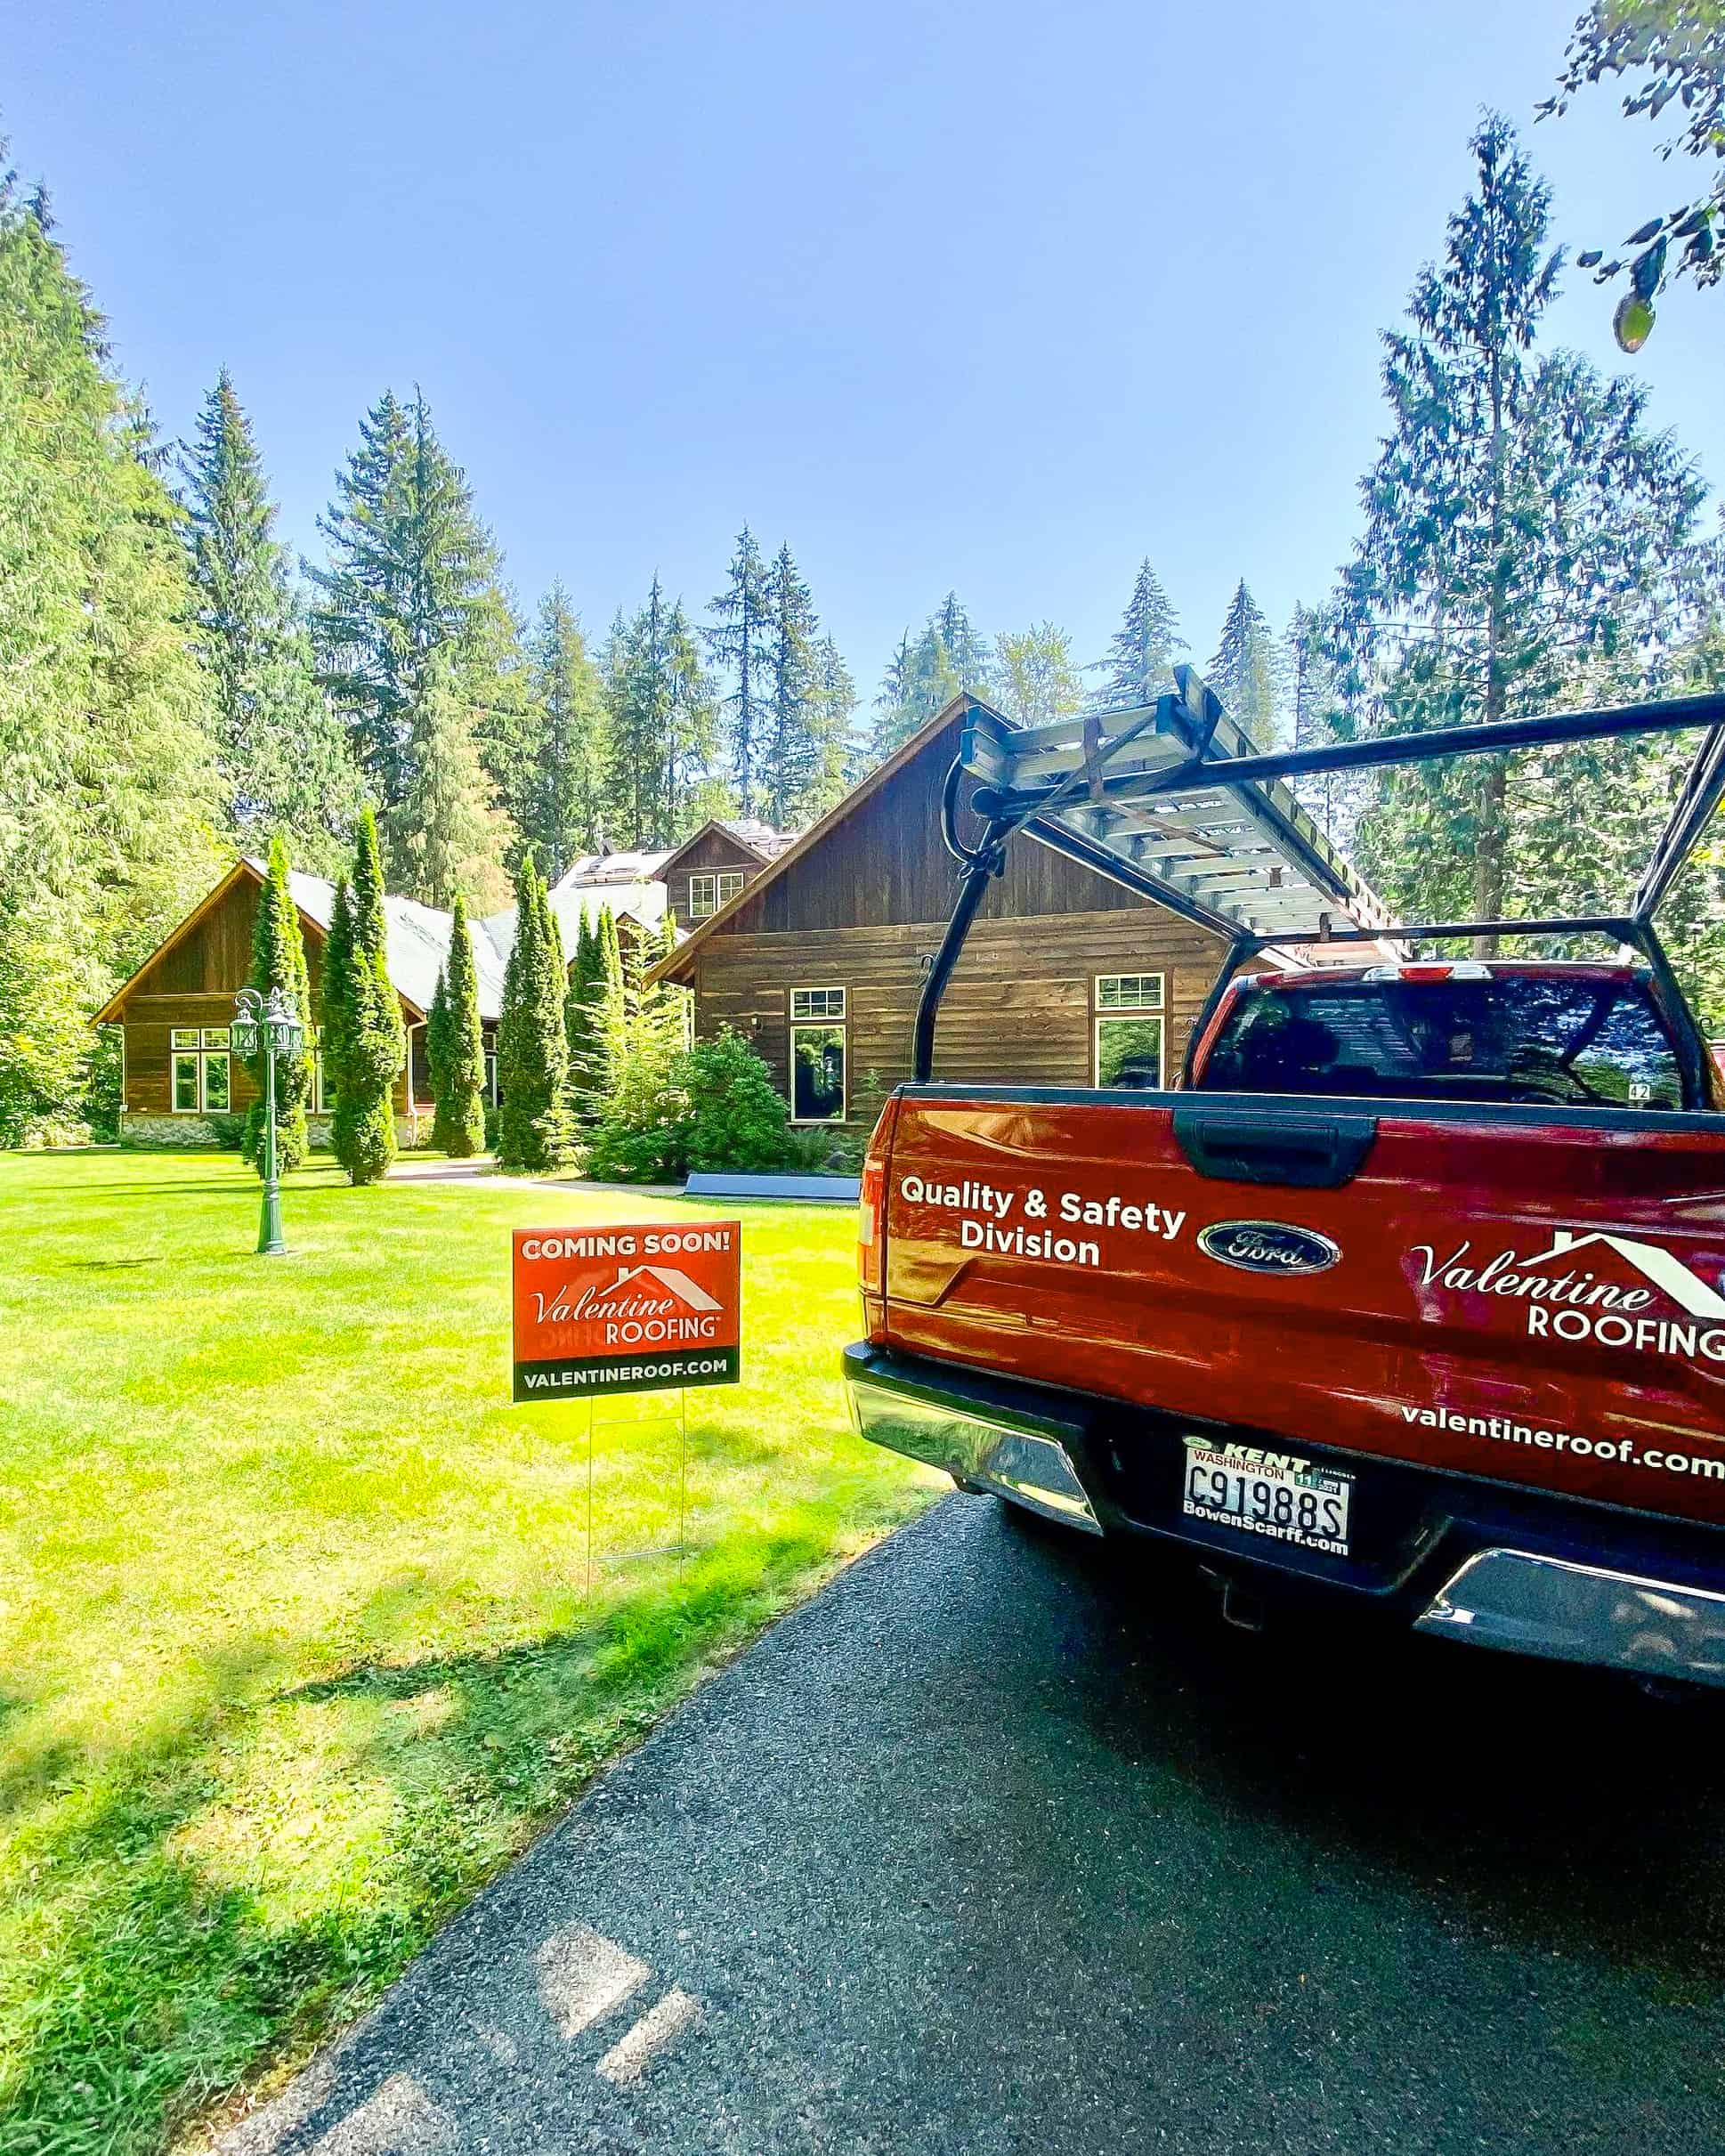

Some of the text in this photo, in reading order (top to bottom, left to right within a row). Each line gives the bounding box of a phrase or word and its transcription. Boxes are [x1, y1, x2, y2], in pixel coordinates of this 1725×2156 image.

[1631, 1085, 1648, 1098] 42
[900, 1175, 1186, 1239] Quality & Safety
[522, 1231, 731, 1260] COMING SOON!
[961, 1220, 1100, 1267] Division
[1227, 1230, 1305, 1265] Ford
[1411, 1240, 1659, 1311] Valentine
[530, 1285, 675, 1325] Valentine
[605, 1316, 717, 1345] ROOFING
[1527, 1304, 1725, 1362] ROOFING
[523, 1358, 728, 1389] VALENTINEROOF.COM
[1223, 1443, 1311, 1473] KENT
[1401, 1405, 1725, 1479] valentineroof.com
[1194, 1449, 1285, 1481] WASHINGTON
[1189, 1465, 1342, 1537] C91988S
[1182, 1499, 1349, 1557] BowenScarff.com
